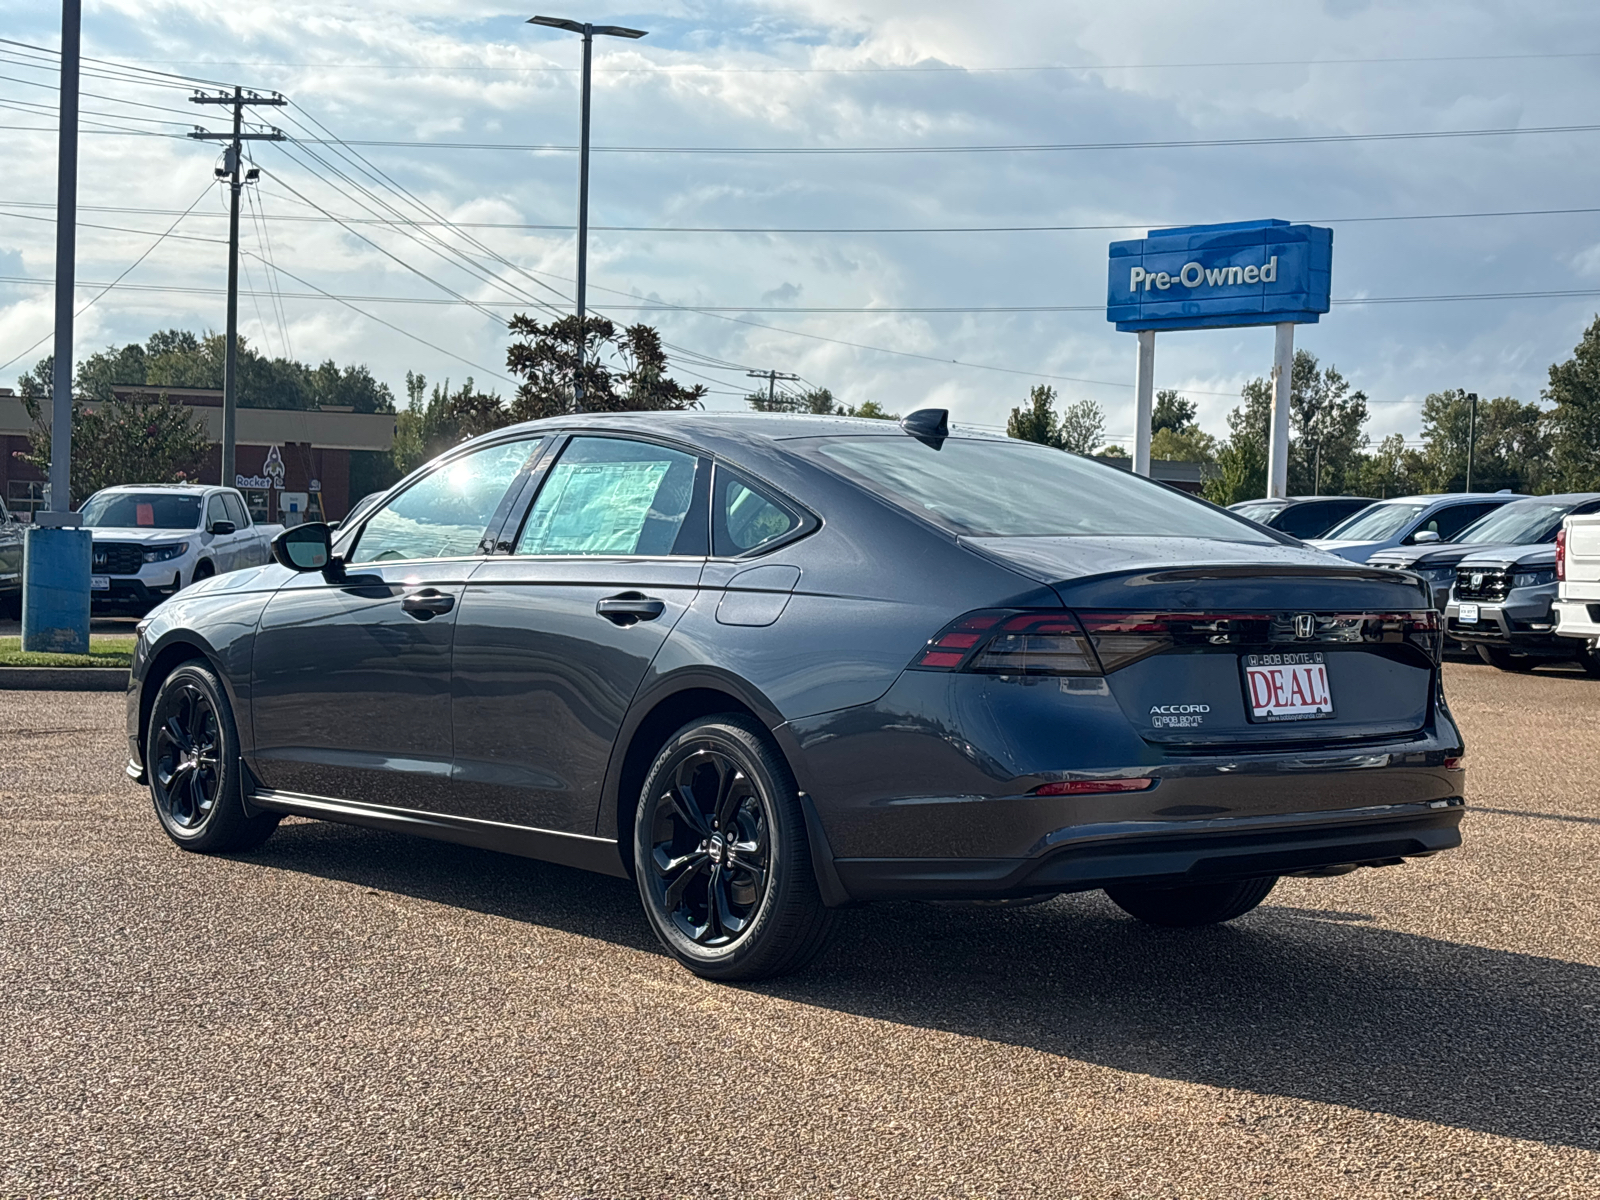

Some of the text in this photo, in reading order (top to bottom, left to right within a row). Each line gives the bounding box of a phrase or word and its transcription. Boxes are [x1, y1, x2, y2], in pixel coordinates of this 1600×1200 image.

[1129, 255, 1278, 292] Pre-Owned
[236, 475, 272, 488] Rocket
[1263, 653, 1310, 665] BOB BOYTE
[1247, 667, 1329, 709] DEAL!
[1150, 704, 1210, 714] ACCORD
[1162, 715, 1203, 724] BOB BOYTE
